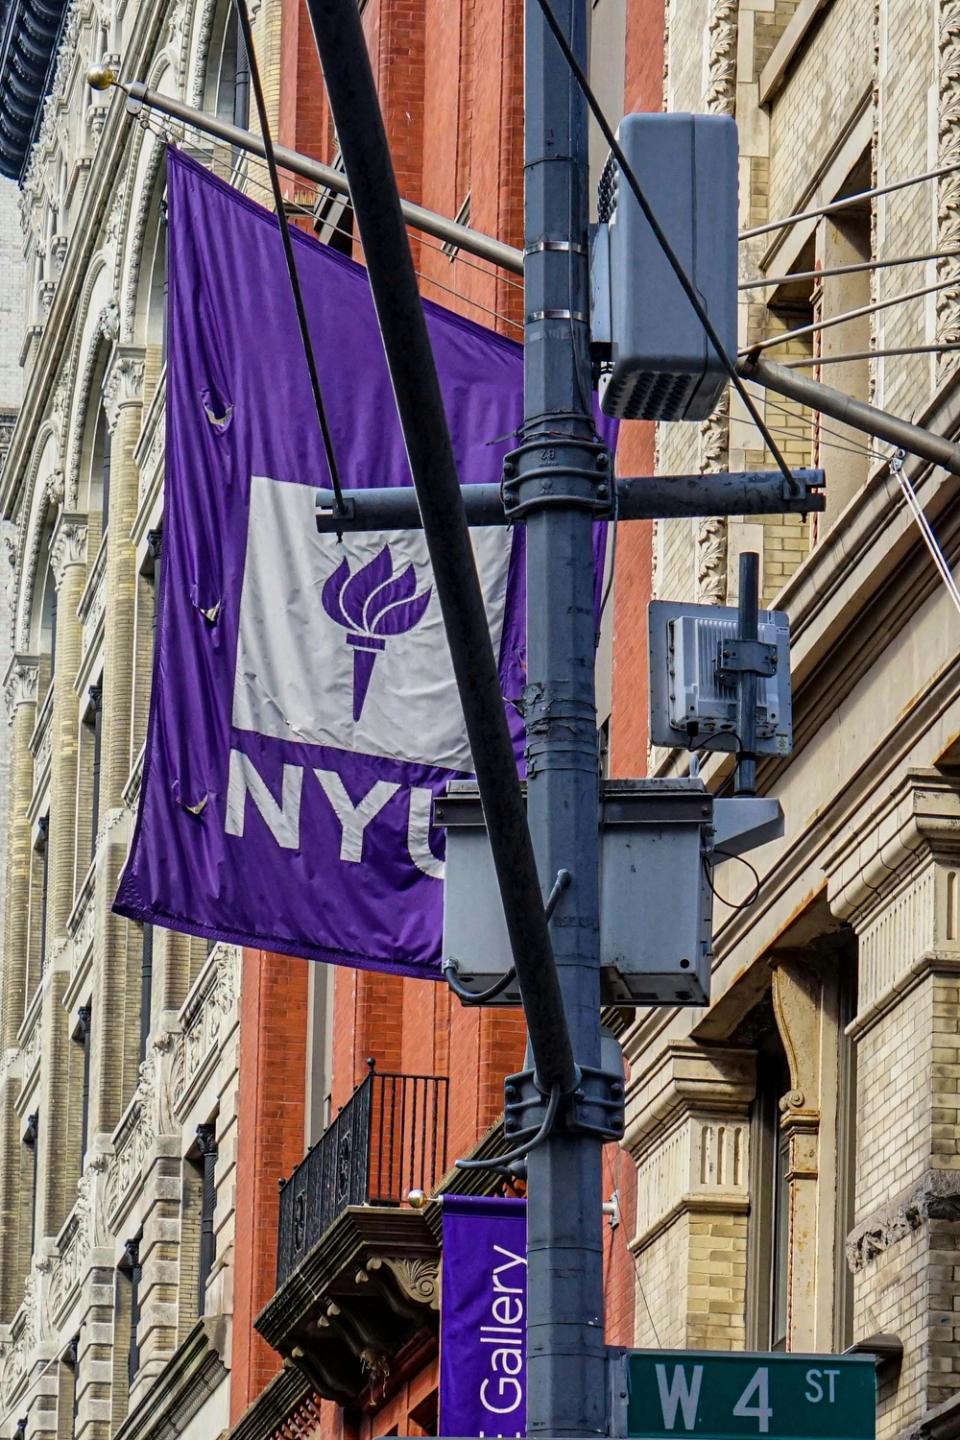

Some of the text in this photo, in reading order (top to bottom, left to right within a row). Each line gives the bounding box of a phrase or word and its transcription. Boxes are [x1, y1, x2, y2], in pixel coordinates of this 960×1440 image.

[480, 1244, 528, 1414] Gallery
[655, 1364, 840, 1433] W 4 ST
